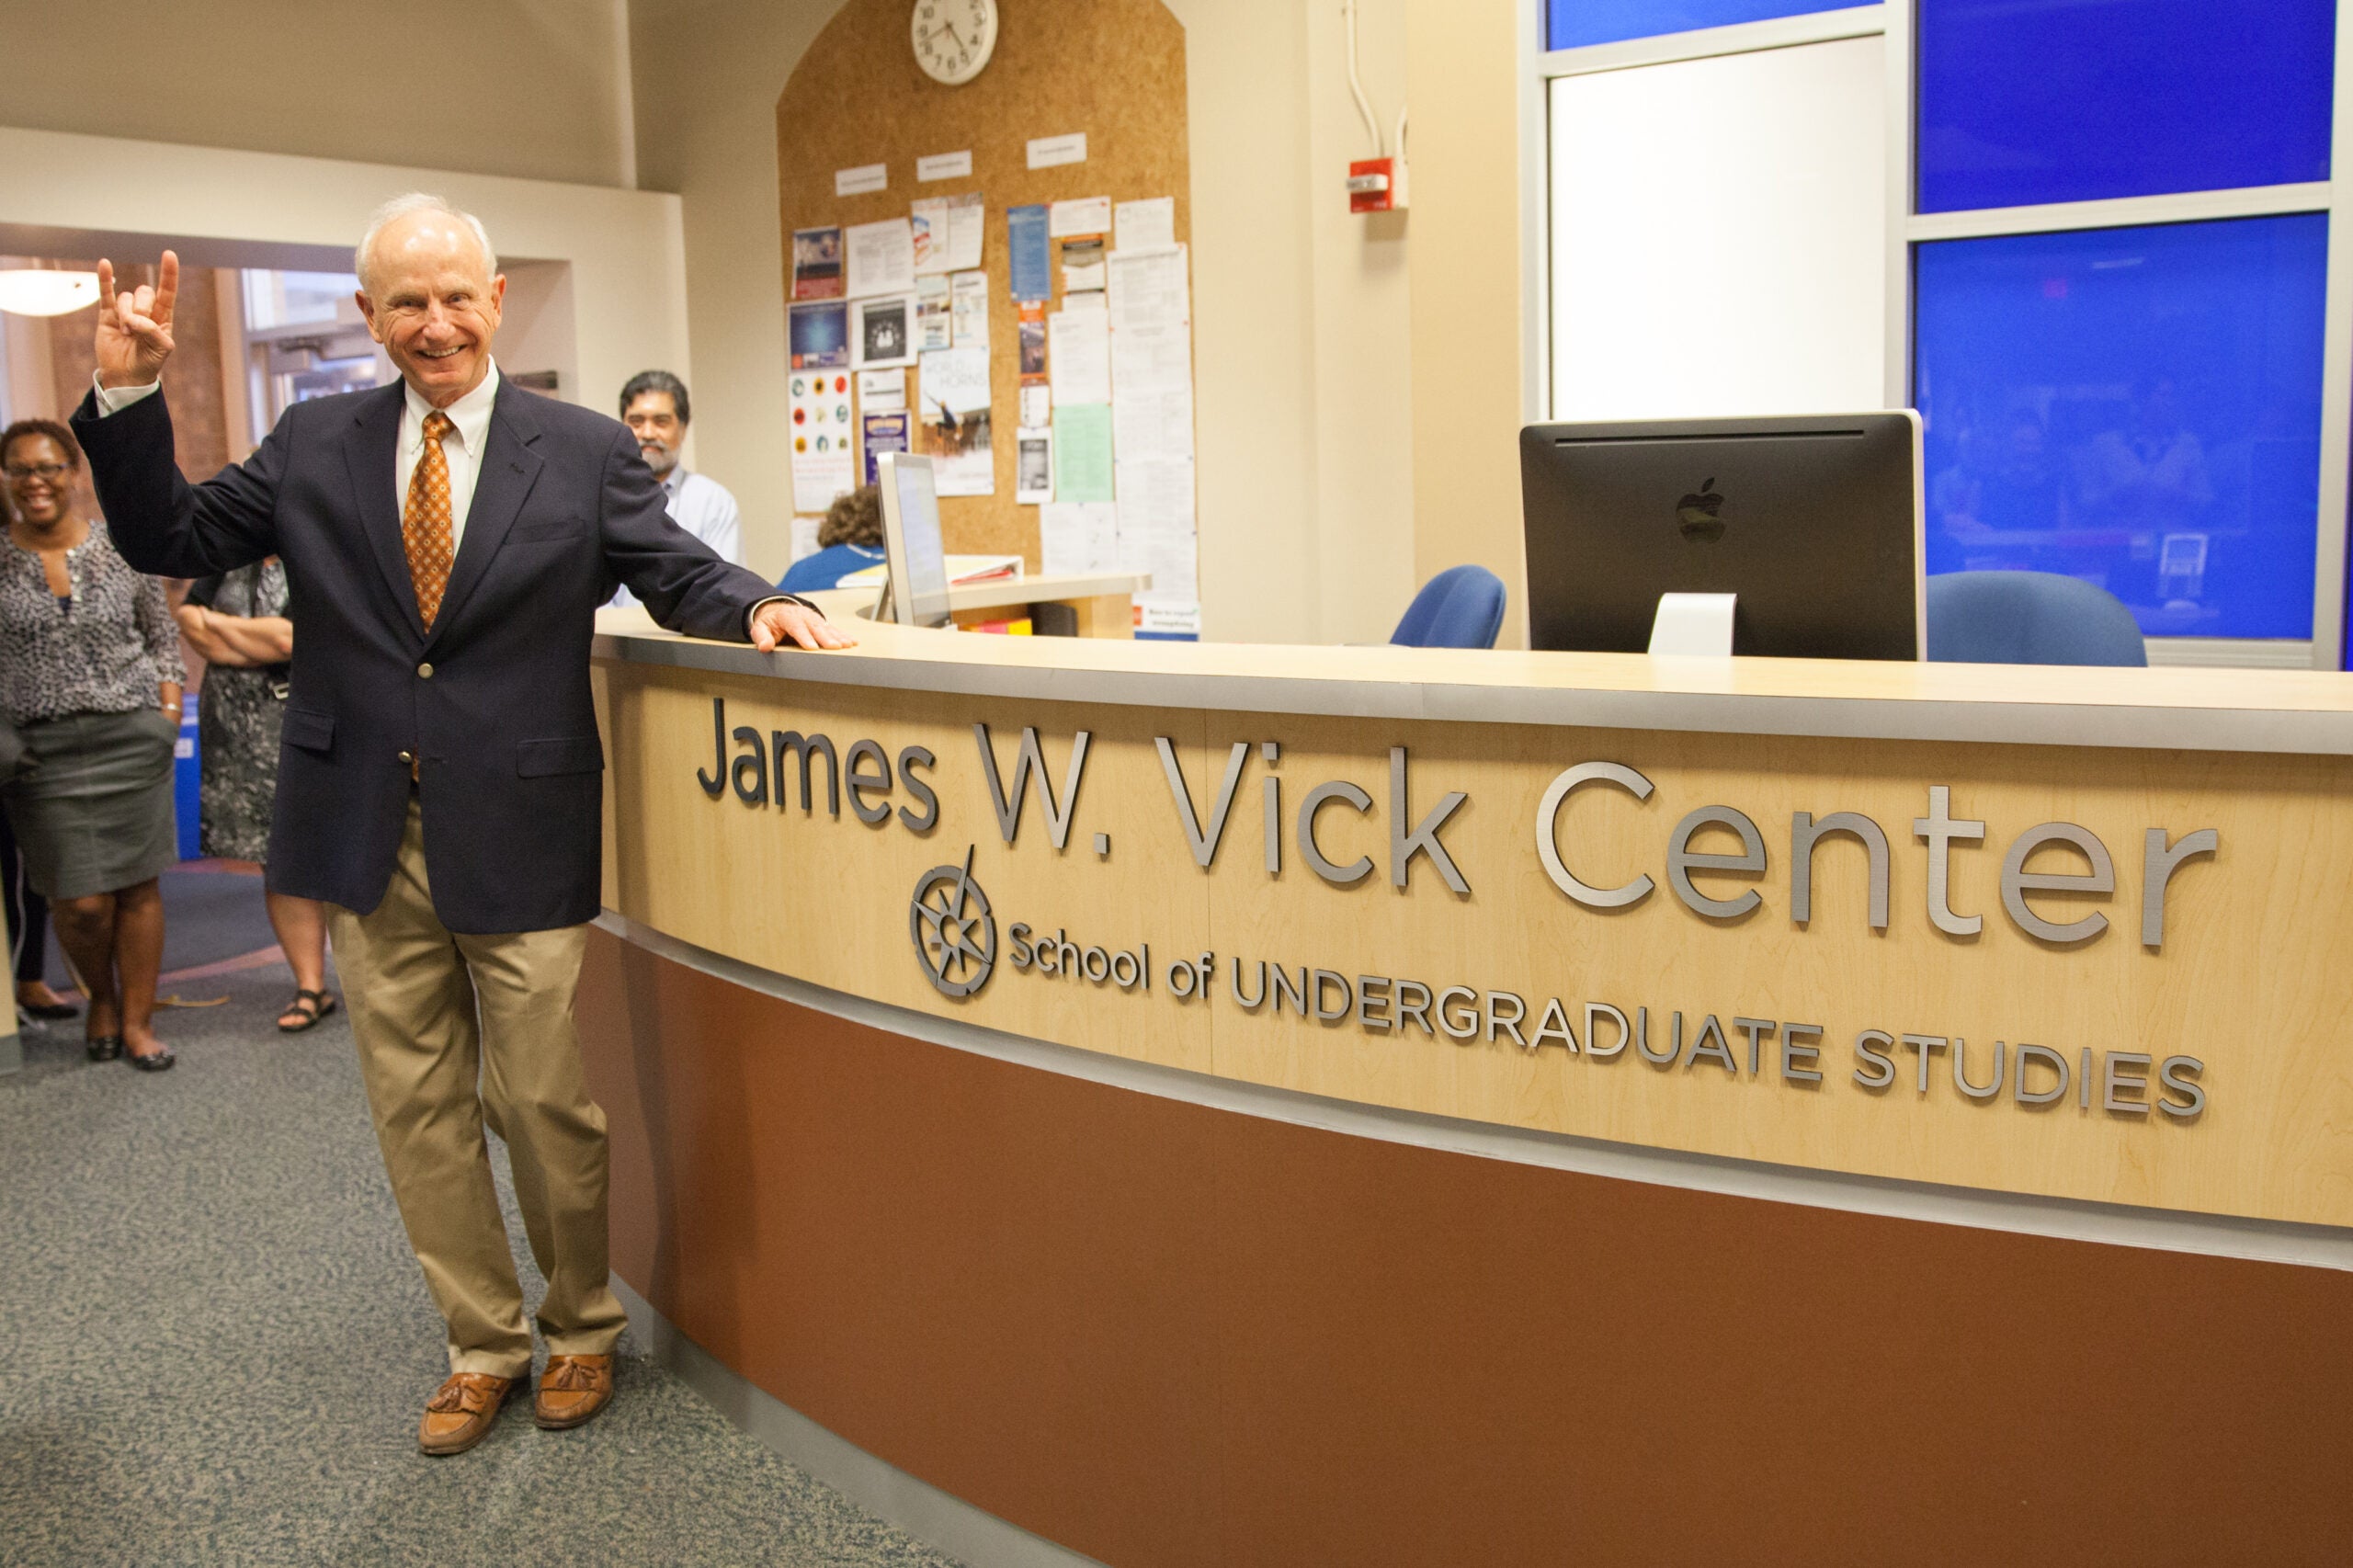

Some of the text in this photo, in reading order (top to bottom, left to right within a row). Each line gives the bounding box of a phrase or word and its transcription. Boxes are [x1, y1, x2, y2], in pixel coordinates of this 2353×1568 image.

[697, 698, 2218, 948] James W. Vick Center
[1009, 923, 2207, 1117] School of UNDERGRADUATE STUDIES
